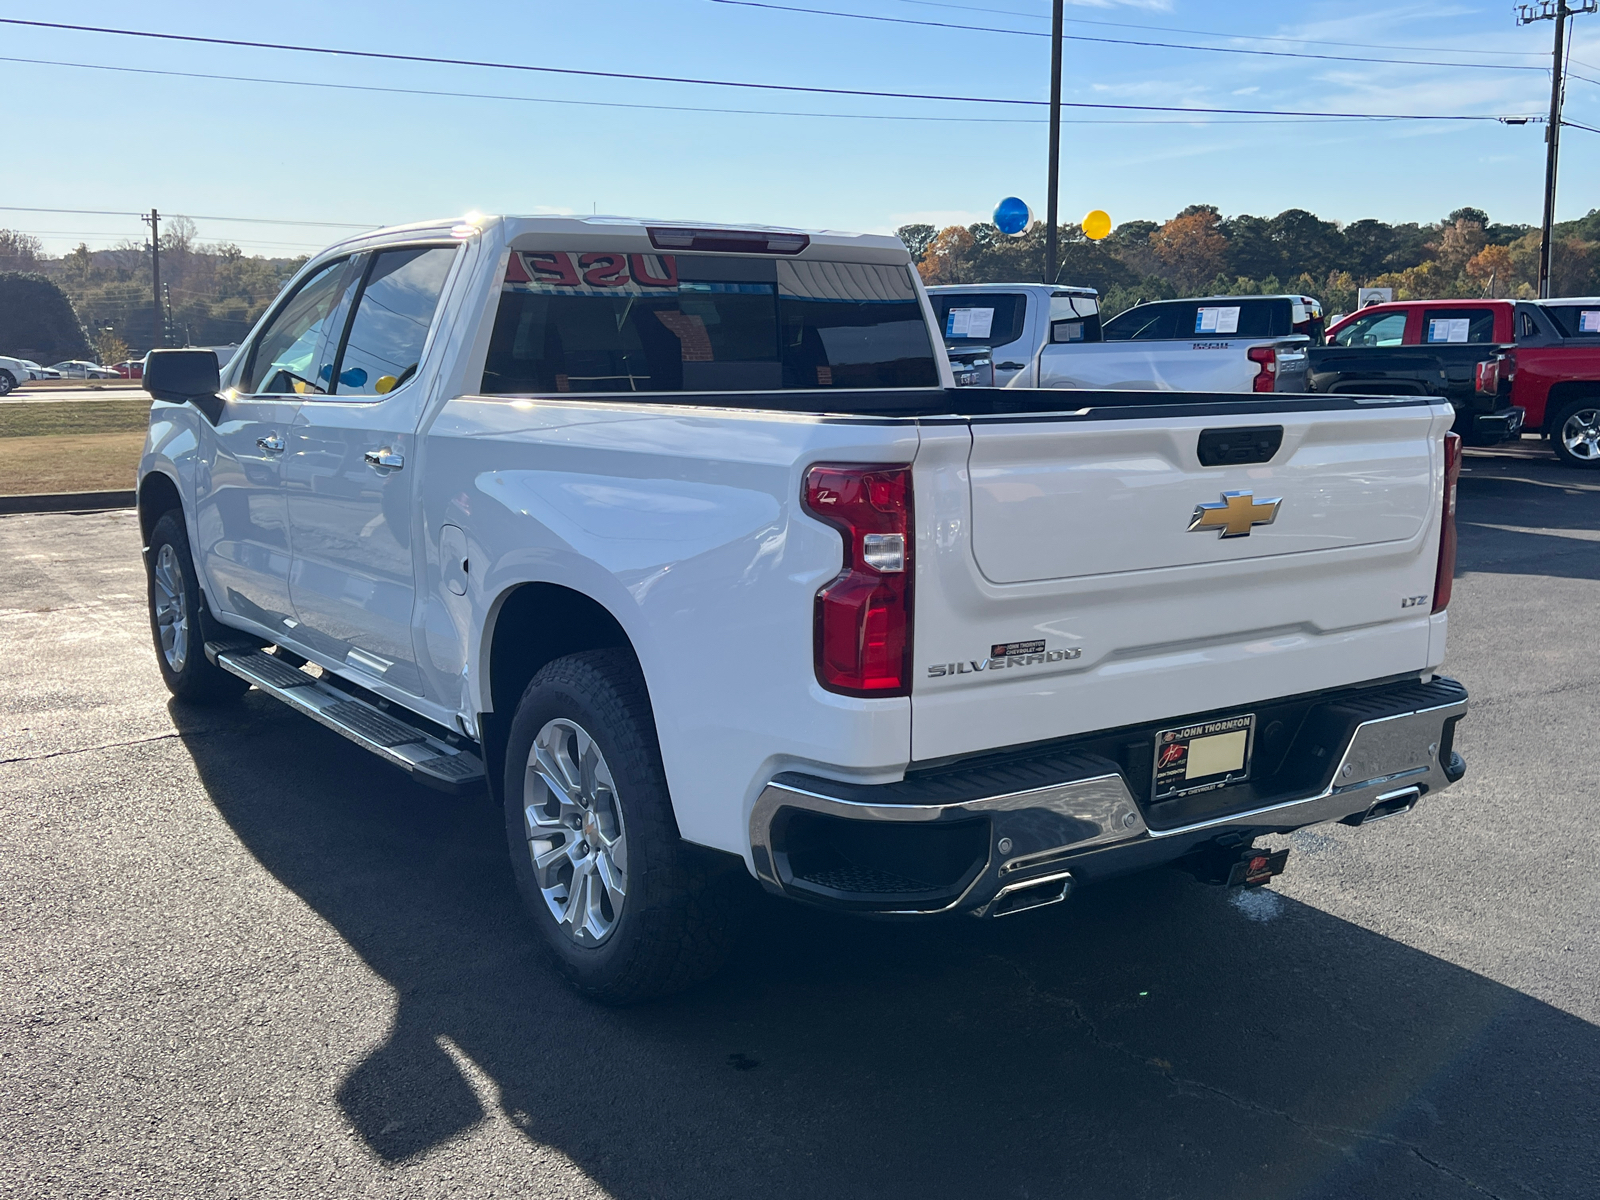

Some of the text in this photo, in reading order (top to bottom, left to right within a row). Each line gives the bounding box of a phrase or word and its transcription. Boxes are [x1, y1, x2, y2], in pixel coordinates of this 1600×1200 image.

[1402, 595, 1428, 608] LTZ
[1006, 640, 1045, 650] JOHN THORNTON
[1005, 647, 1035, 656] CHEVROLET
[928, 647, 1082, 678] SILVERADO
[1180, 717, 1250, 738] JOHN THORNTON
[1188, 784, 1216, 795] CHEVROLET
